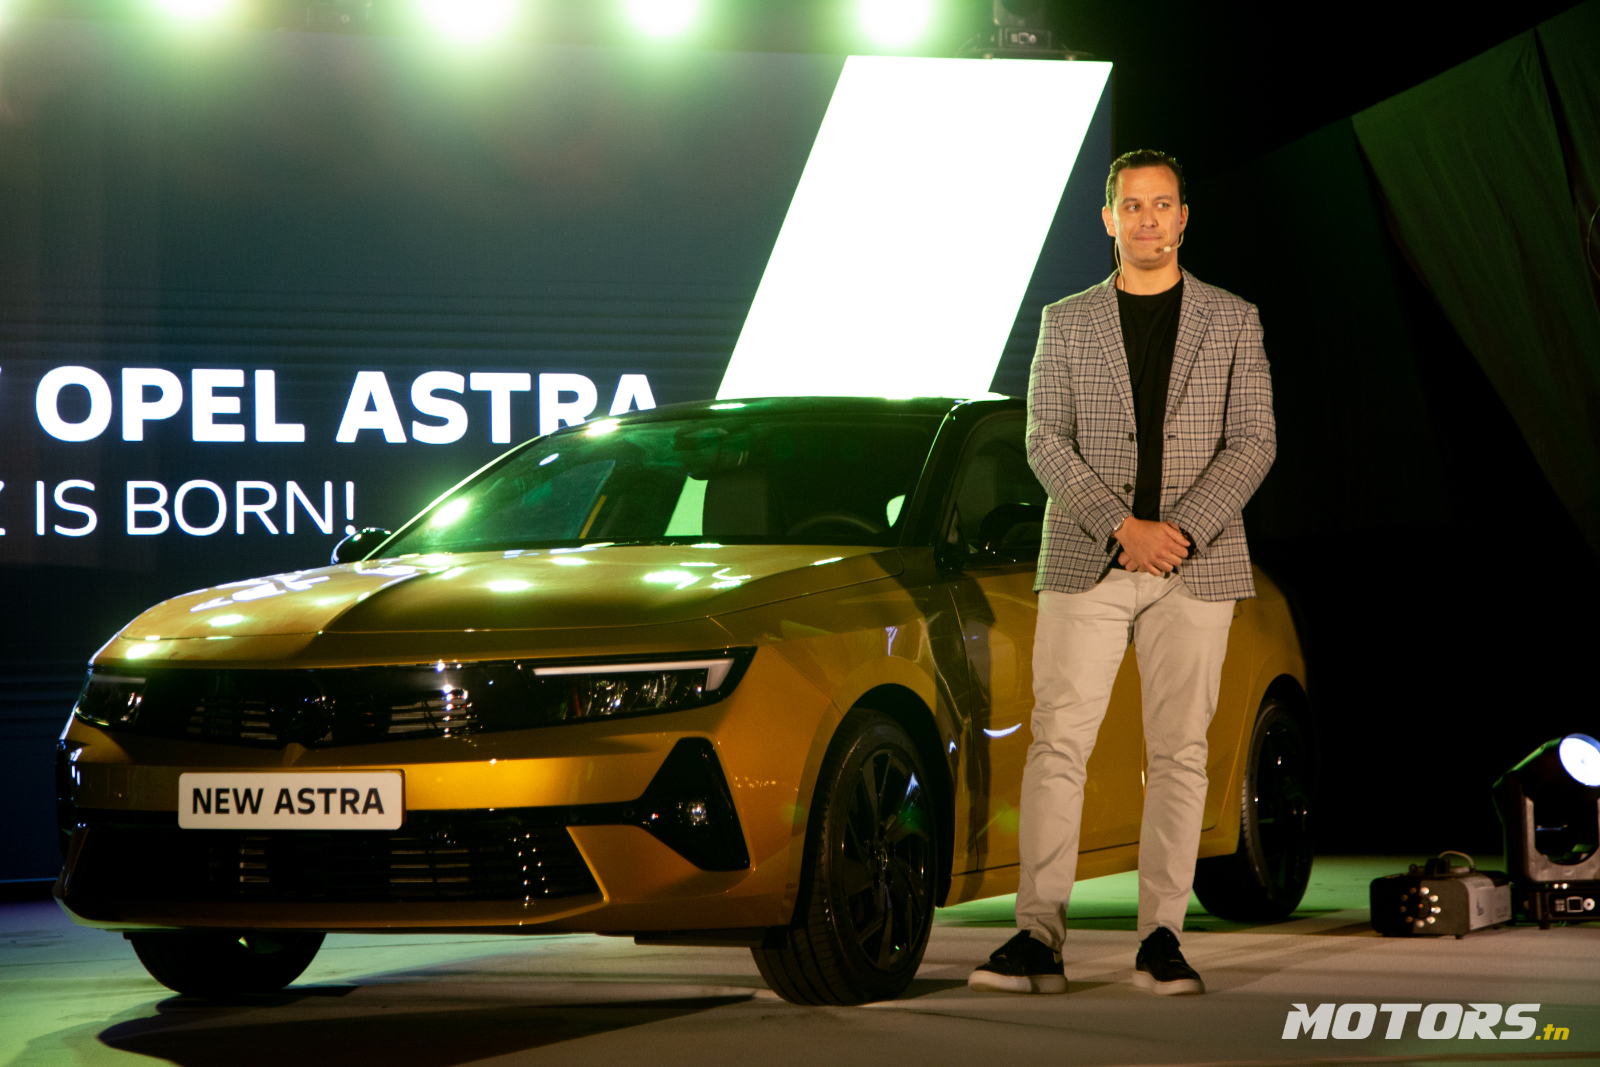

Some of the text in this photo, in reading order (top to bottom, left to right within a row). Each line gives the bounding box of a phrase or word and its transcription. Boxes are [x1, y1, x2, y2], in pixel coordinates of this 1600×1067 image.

[35, 365, 306, 443] OPEL
[36, 479, 98, 537] IS
[126, 479, 356, 536] BORN!
[192, 787, 385, 815] NEW ASTRA
